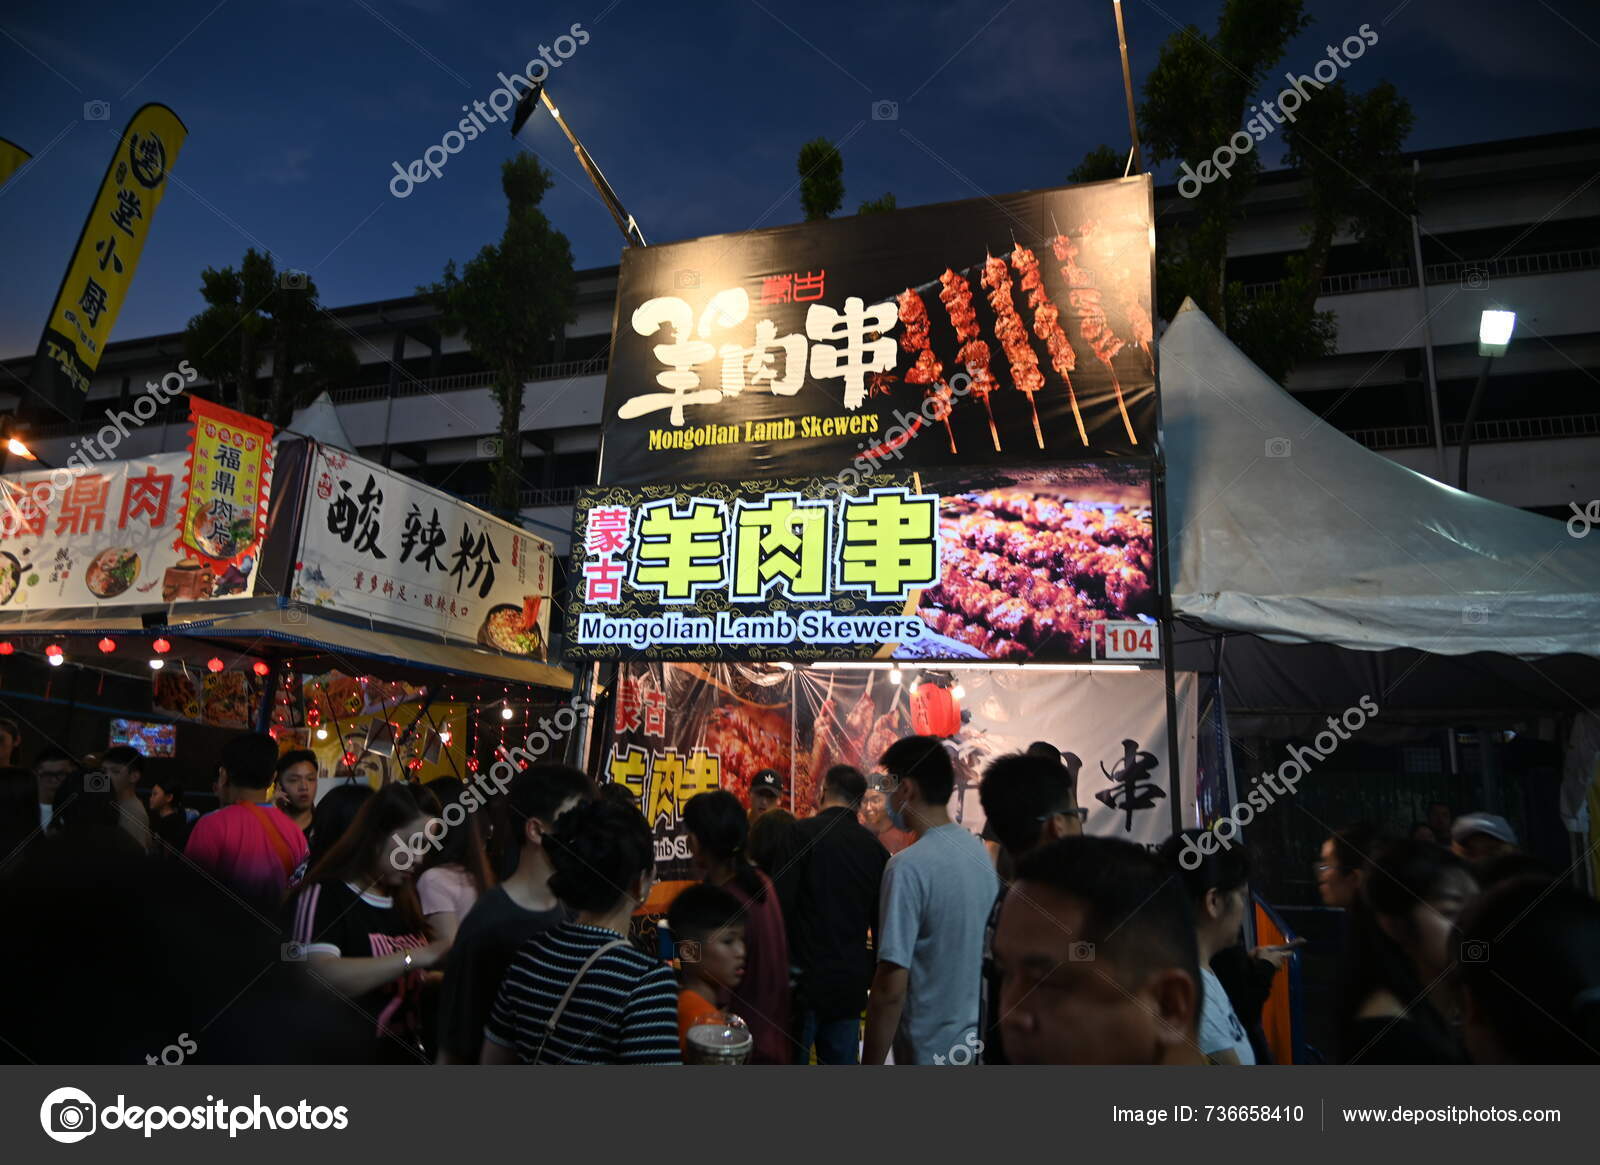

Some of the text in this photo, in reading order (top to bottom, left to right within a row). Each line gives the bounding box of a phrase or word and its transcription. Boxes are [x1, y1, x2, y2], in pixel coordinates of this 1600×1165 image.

[617, 287, 899, 426] 羊肉串
[649, 413, 879, 450] Mongolian Lamb Skewers
[207, 444, 242, 544] 福鼎肉片
[327, 473, 500, 599] 酸辣粉
[585, 508, 630, 602] 蒙古
[632, 491, 937, 600] 羊肉串
[582, 615, 921, 642] Mongolian Lamb Skewers
[1108, 629, 1153, 652] 104
